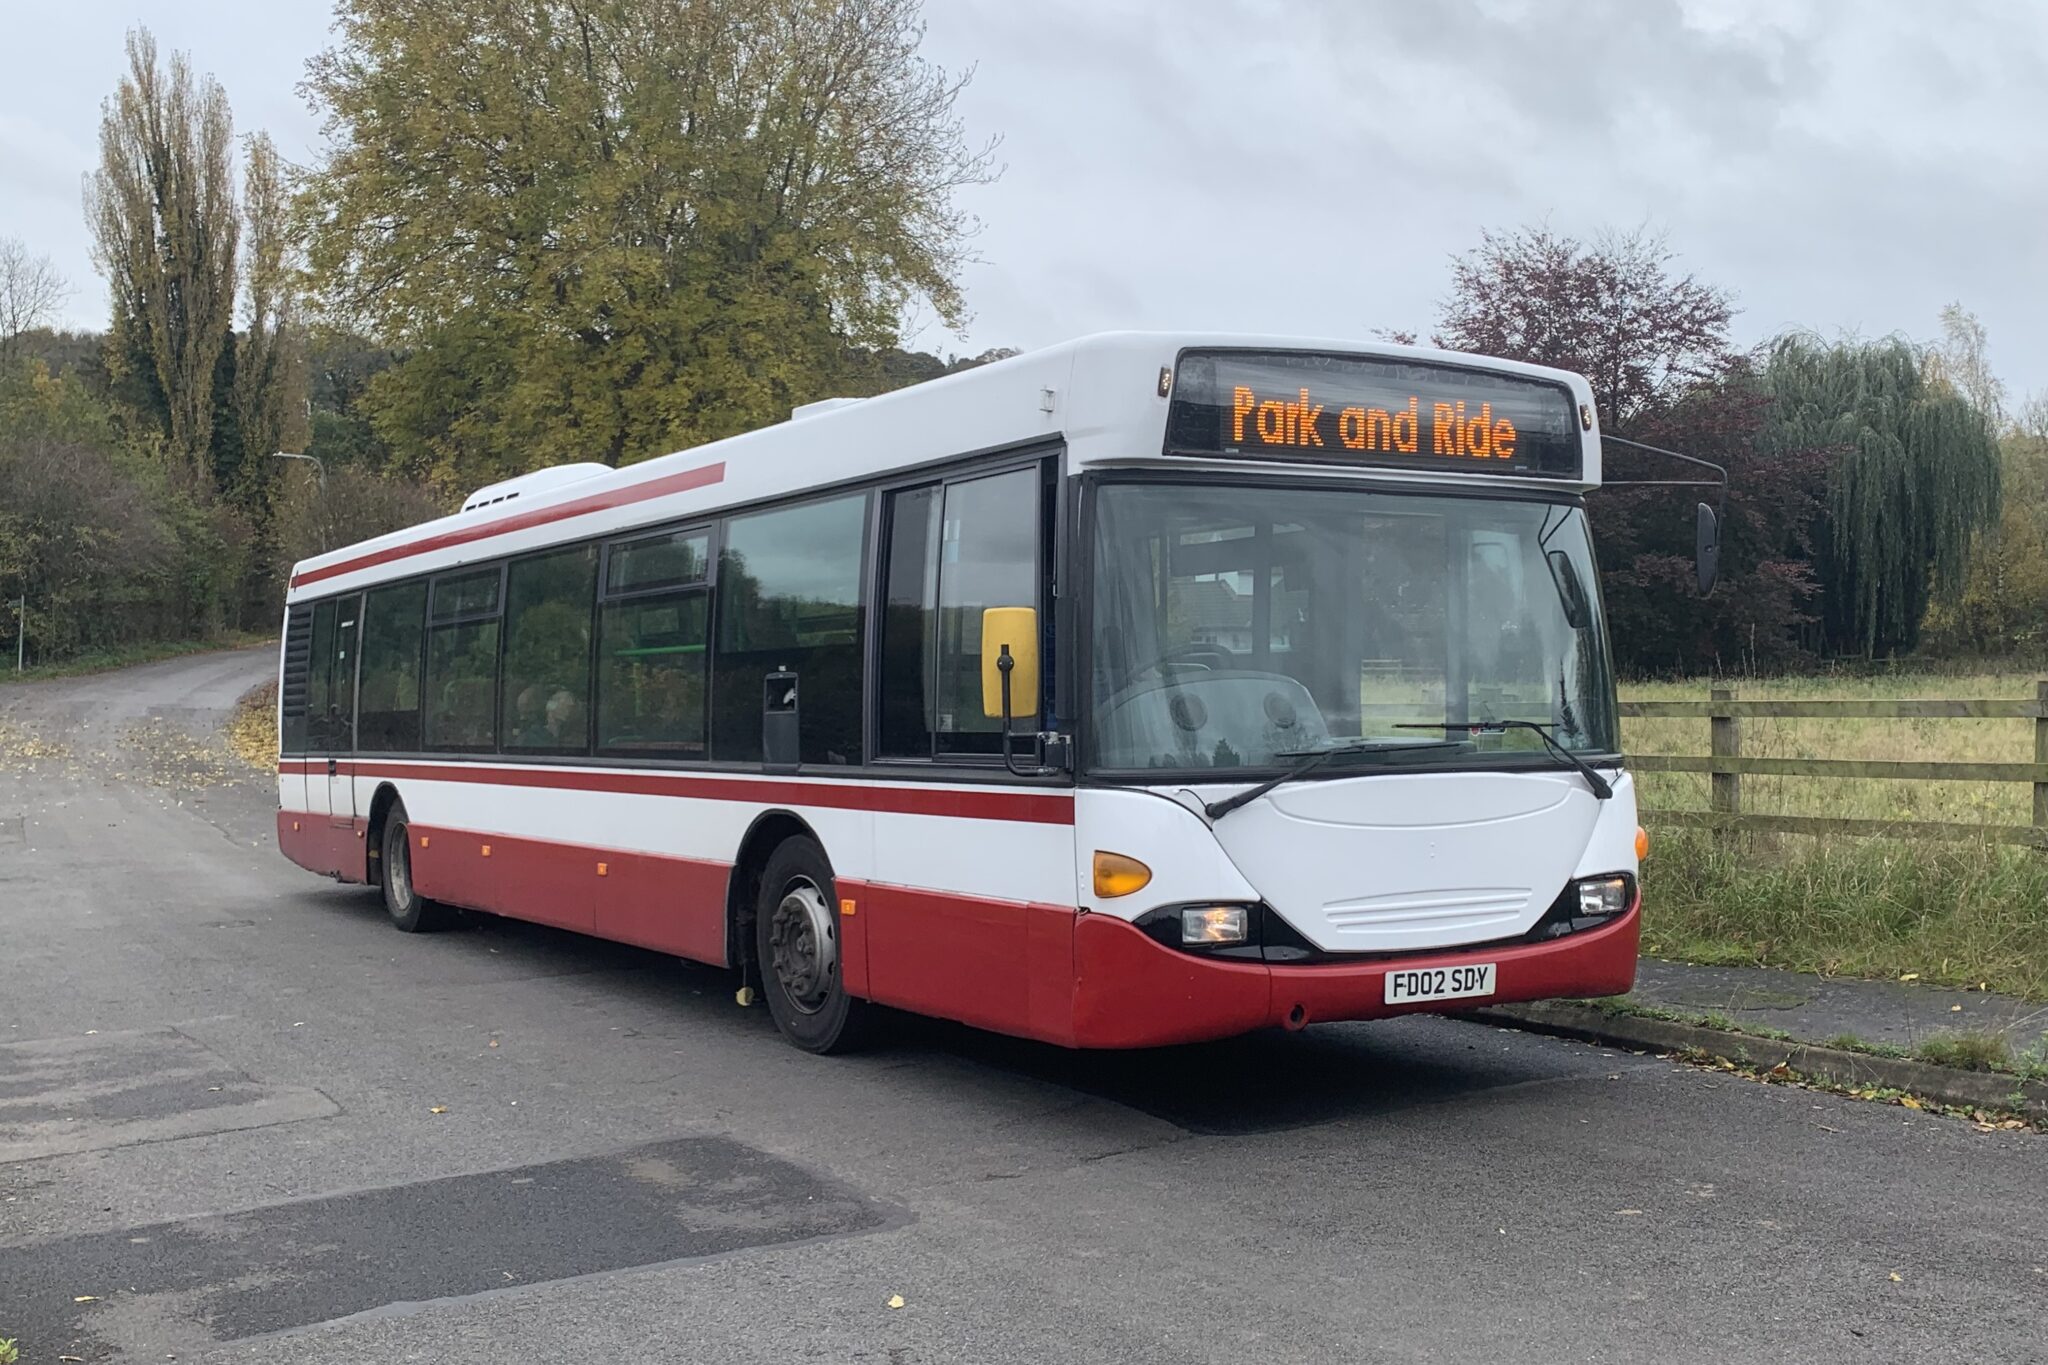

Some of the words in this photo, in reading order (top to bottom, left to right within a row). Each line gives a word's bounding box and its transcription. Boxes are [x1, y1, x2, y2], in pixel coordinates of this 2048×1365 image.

[1233, 386, 1324, 447] Park
[1338, 396, 1418, 453] and
[1434, 400, 1516, 459] Ride
[1393, 970, 1446, 998] FD02
[1451, 966, 1488, 993] SDY
